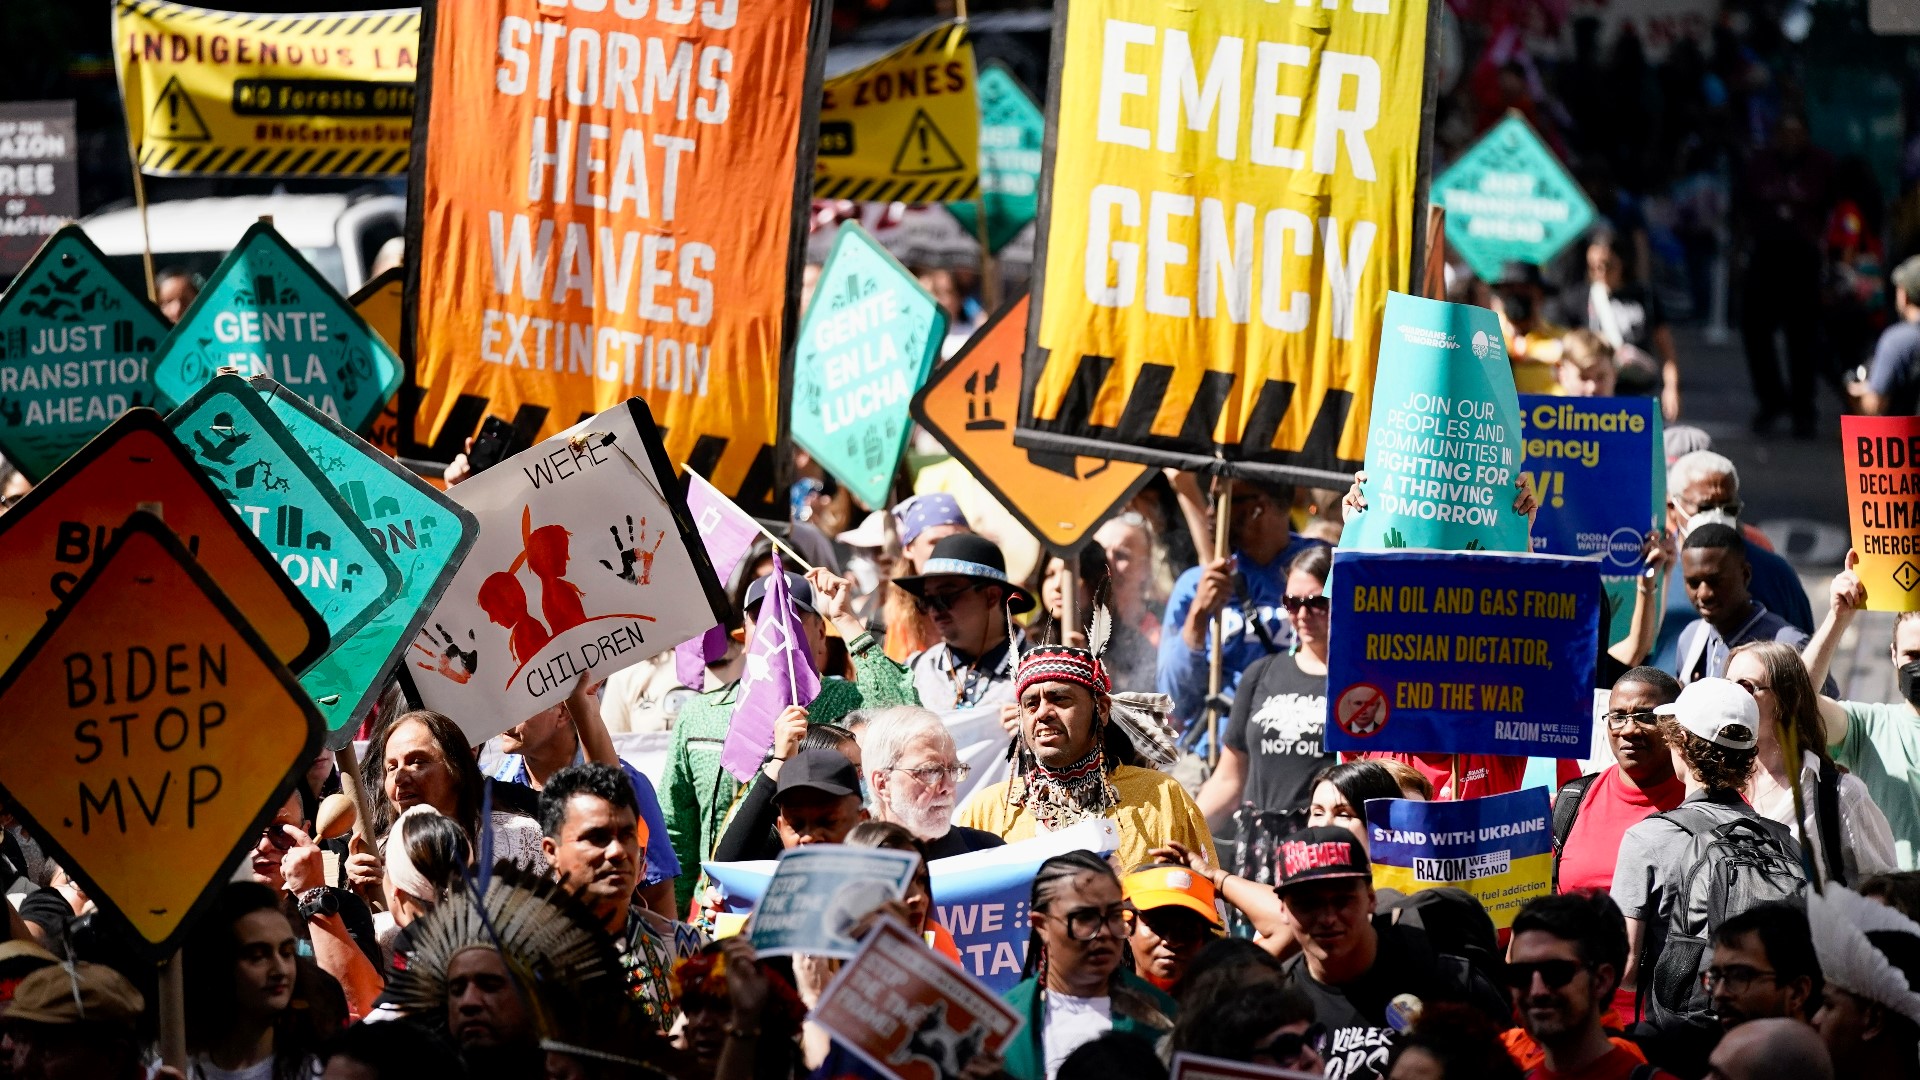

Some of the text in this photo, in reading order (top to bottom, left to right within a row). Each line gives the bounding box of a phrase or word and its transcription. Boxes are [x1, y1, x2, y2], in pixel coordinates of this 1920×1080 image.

[129, 33, 417, 69] INDIGENOUS LA
[497, 15, 733, 124] STORMS
[854, 61, 965, 106] ZONES
[279, 86, 365, 110] Forests
[1097, 18, 1381, 182] EMER
[528, 116, 696, 221] HEAT
[488, 210, 716, 327] WAVES
[1084, 184, 1377, 341] GENCY
[213, 311, 328, 343] GENTE
[815, 289, 897, 352] GENTE
[31, 325, 107, 355] JUST
[481, 309, 711, 397] EXTINCTION
[227, 354, 328, 385] EN LA
[825, 332, 897, 391] EN LA
[25, 395, 128, 427] AHEAD
[821, 369, 909, 434] LUCHA
[1402, 392, 1451, 415] JOIN
[1458, 399, 1494, 421] OUR
[1532, 404, 1645, 433] Climate
[1388, 409, 1504, 443] PEOPLES AND
[1375, 428, 1512, 465] COMMUNITIES IN
[1376, 450, 1509, 486] FIGHTING FOR
[1383, 473, 1494, 505] A THRIVING
[1379, 492, 1498, 527] TOMORROW
[1354, 585, 1577, 620] BAN OIL AND GAS FROM
[526, 621, 645, 697] CHILDREN
[1366, 633, 1553, 671] RUSSIAN DICTATOR,
[63, 643, 227, 708] BIDEN
[1396, 682, 1524, 713] END THE WAR
[74, 702, 226, 764] STOP
[1495, 720, 1539, 742] RAZOM
[1541, 724, 1559, 732] WE
[1541, 733, 1579, 744] STAND
[1261, 739, 1324, 757] NOT OIL
[1374, 817, 1545, 846] STAND WITH UKRAINE
[1416, 858, 1467, 882] RAZOM
[1468, 855, 1487, 867] WE
[1469, 863, 1508, 879] STAND
[1482, 888, 1500, 900] fuel
[1502, 881, 1546, 896] addiction
[937, 903, 1005, 935] WE
[956, 940, 1030, 976] TA
